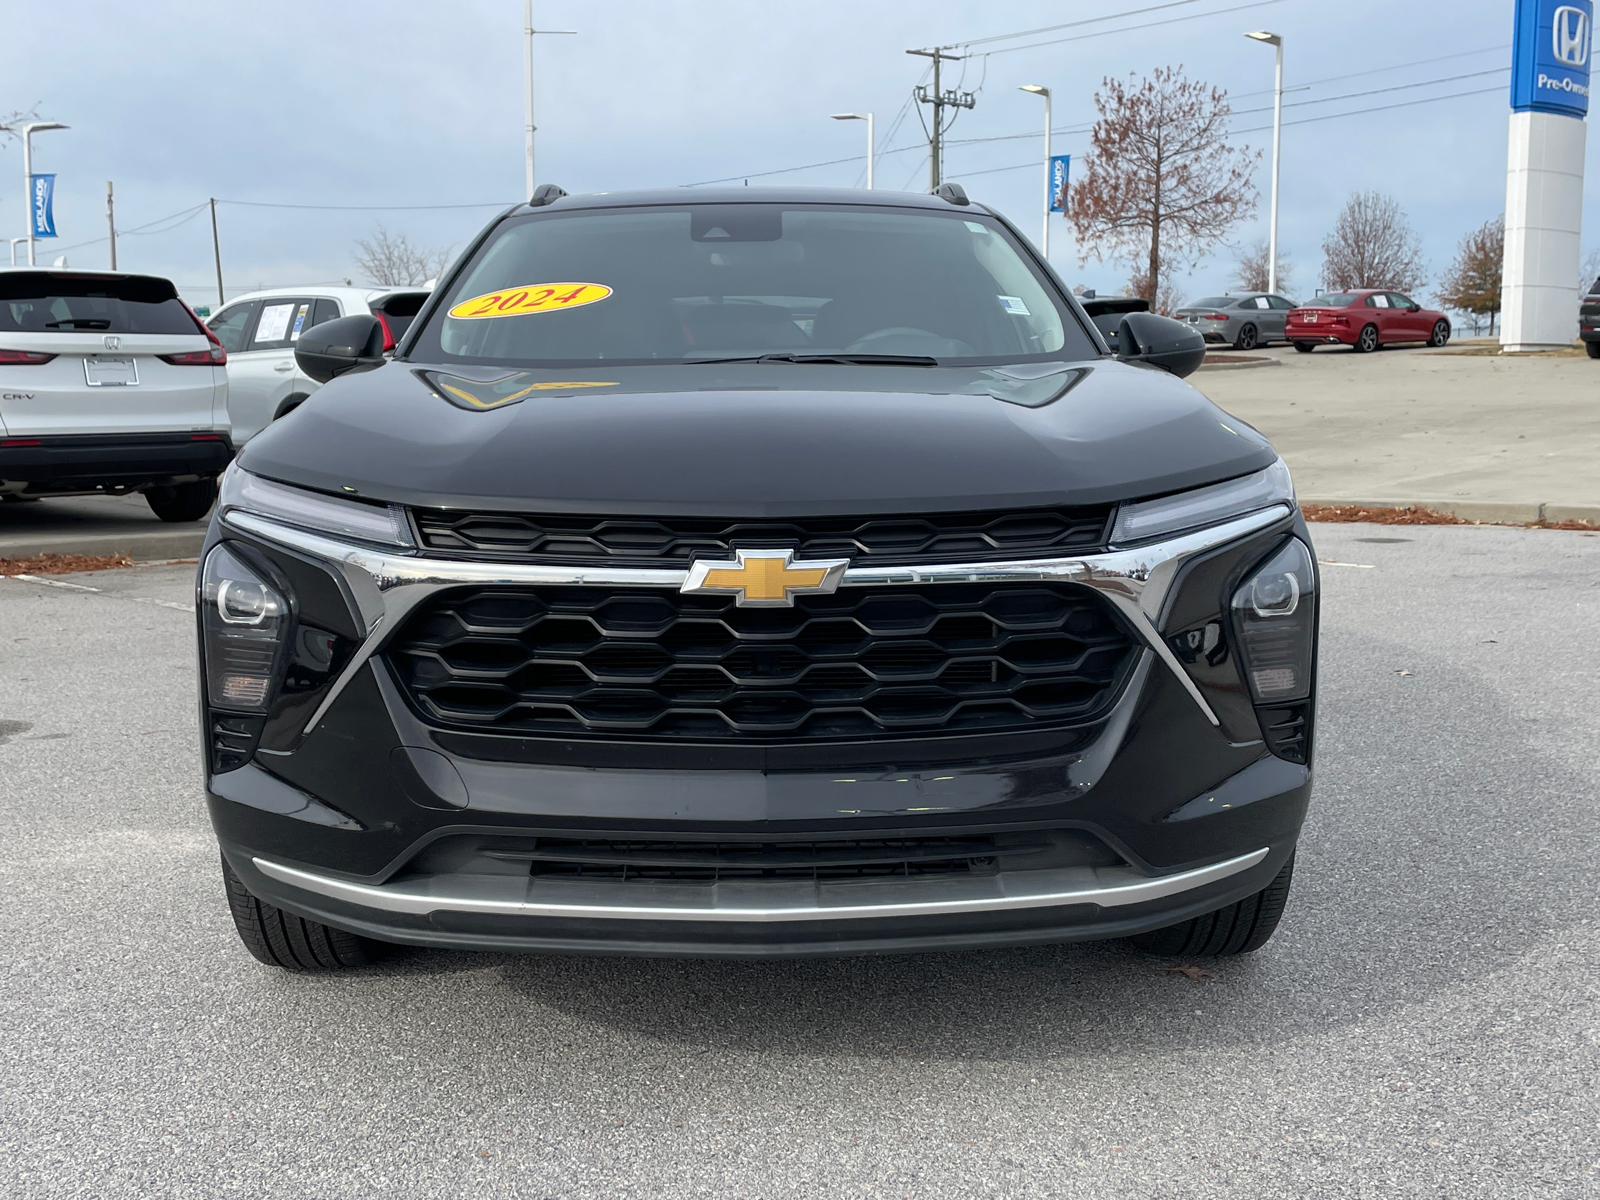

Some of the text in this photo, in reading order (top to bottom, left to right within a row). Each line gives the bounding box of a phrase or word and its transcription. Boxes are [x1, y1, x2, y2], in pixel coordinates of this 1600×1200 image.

[1538, 73, 1589, 97] Pre-Owne
[36, 178, 45, 232] MIDLANDS
[468, 285, 588, 316] 2024
